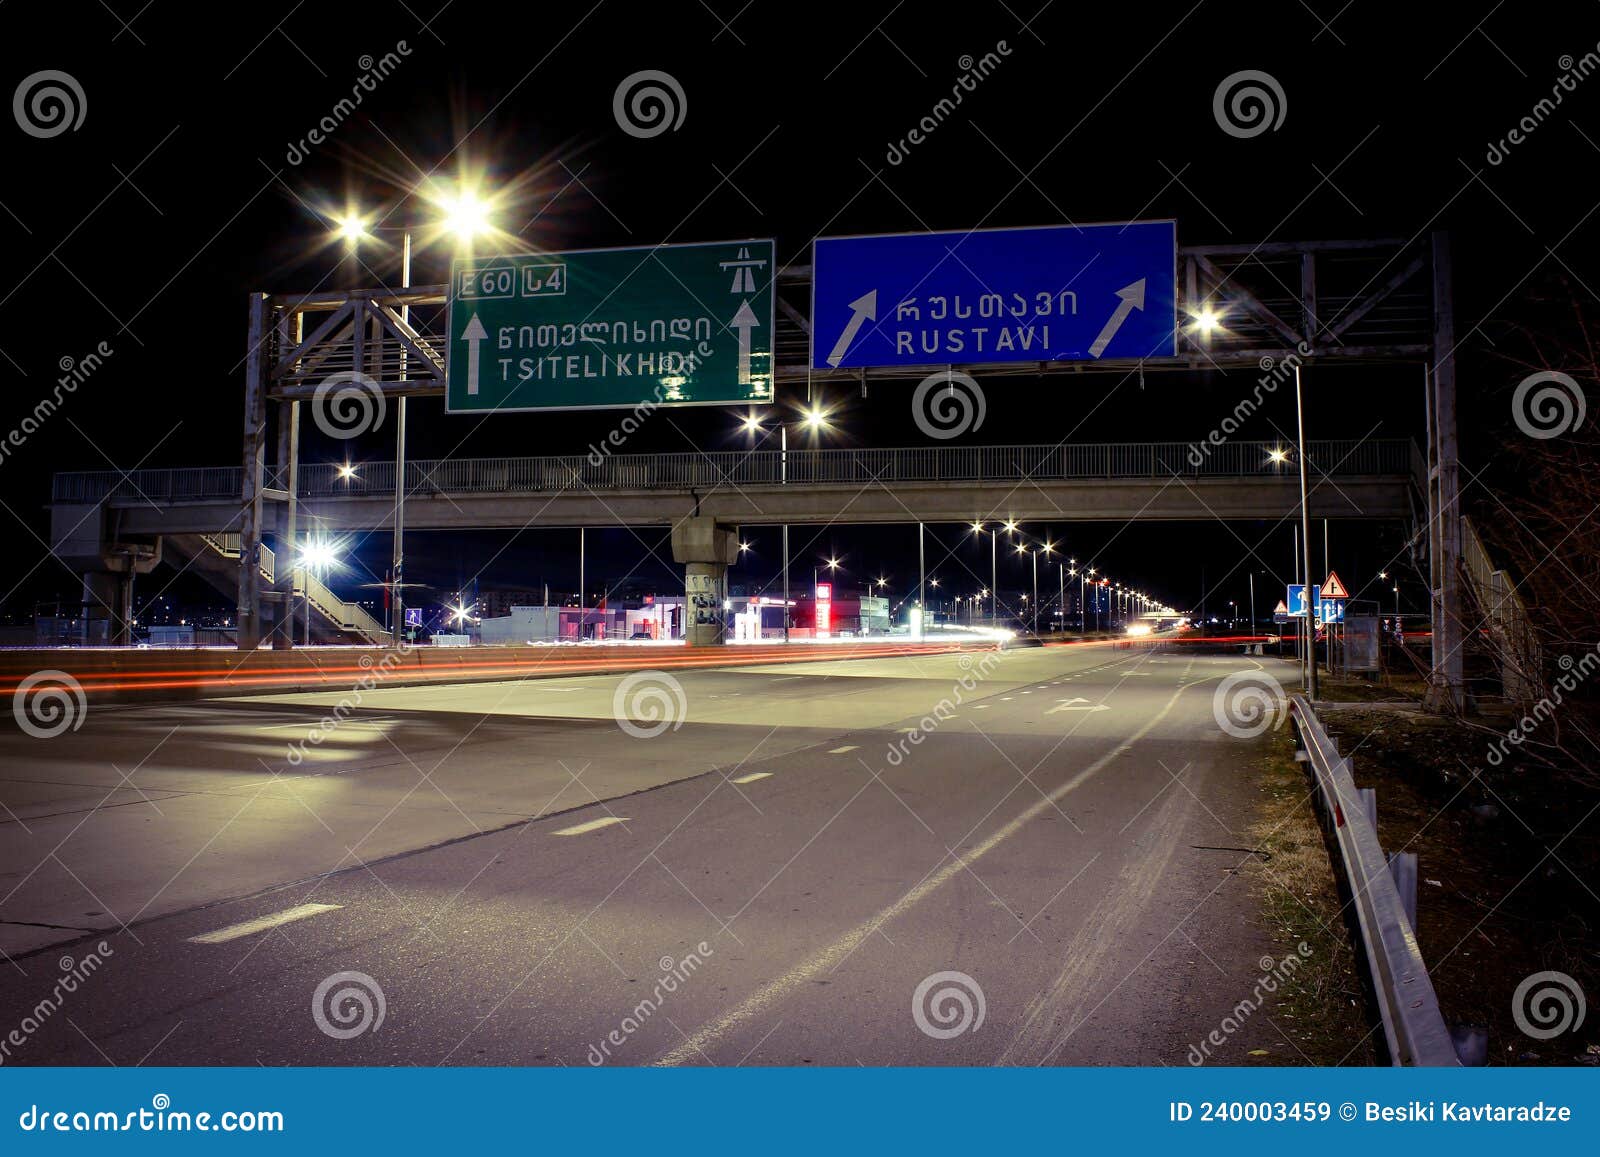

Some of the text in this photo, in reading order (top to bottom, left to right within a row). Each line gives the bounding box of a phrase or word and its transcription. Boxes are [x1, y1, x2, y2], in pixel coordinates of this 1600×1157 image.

[481, 270, 511, 294] 60
[897, 291, 1077, 321] რუსთავი
[896, 325, 1050, 355] RUSTAVI
